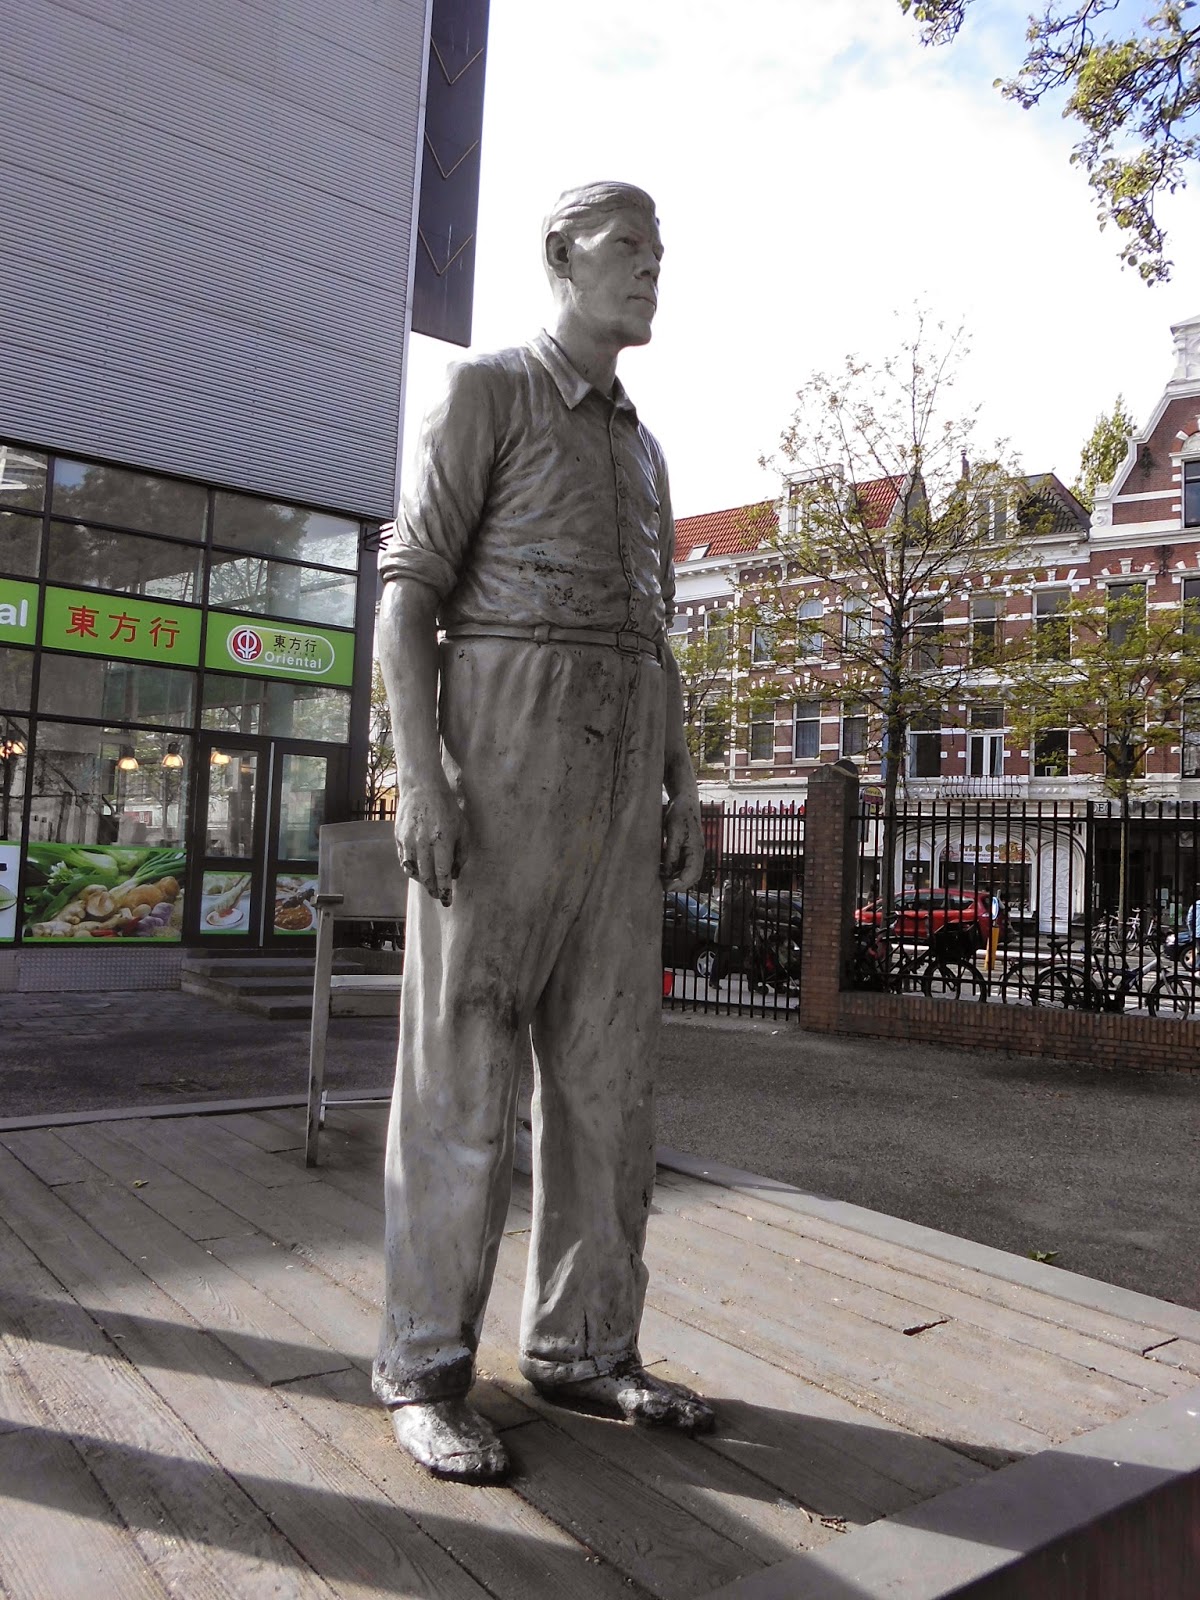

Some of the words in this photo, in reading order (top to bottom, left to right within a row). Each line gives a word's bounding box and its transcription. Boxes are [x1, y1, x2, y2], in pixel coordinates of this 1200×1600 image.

[65, 604, 181, 649] 東方行
[273, 634, 317, 654] 東方行
[264, 651, 322, 669] Oriental
